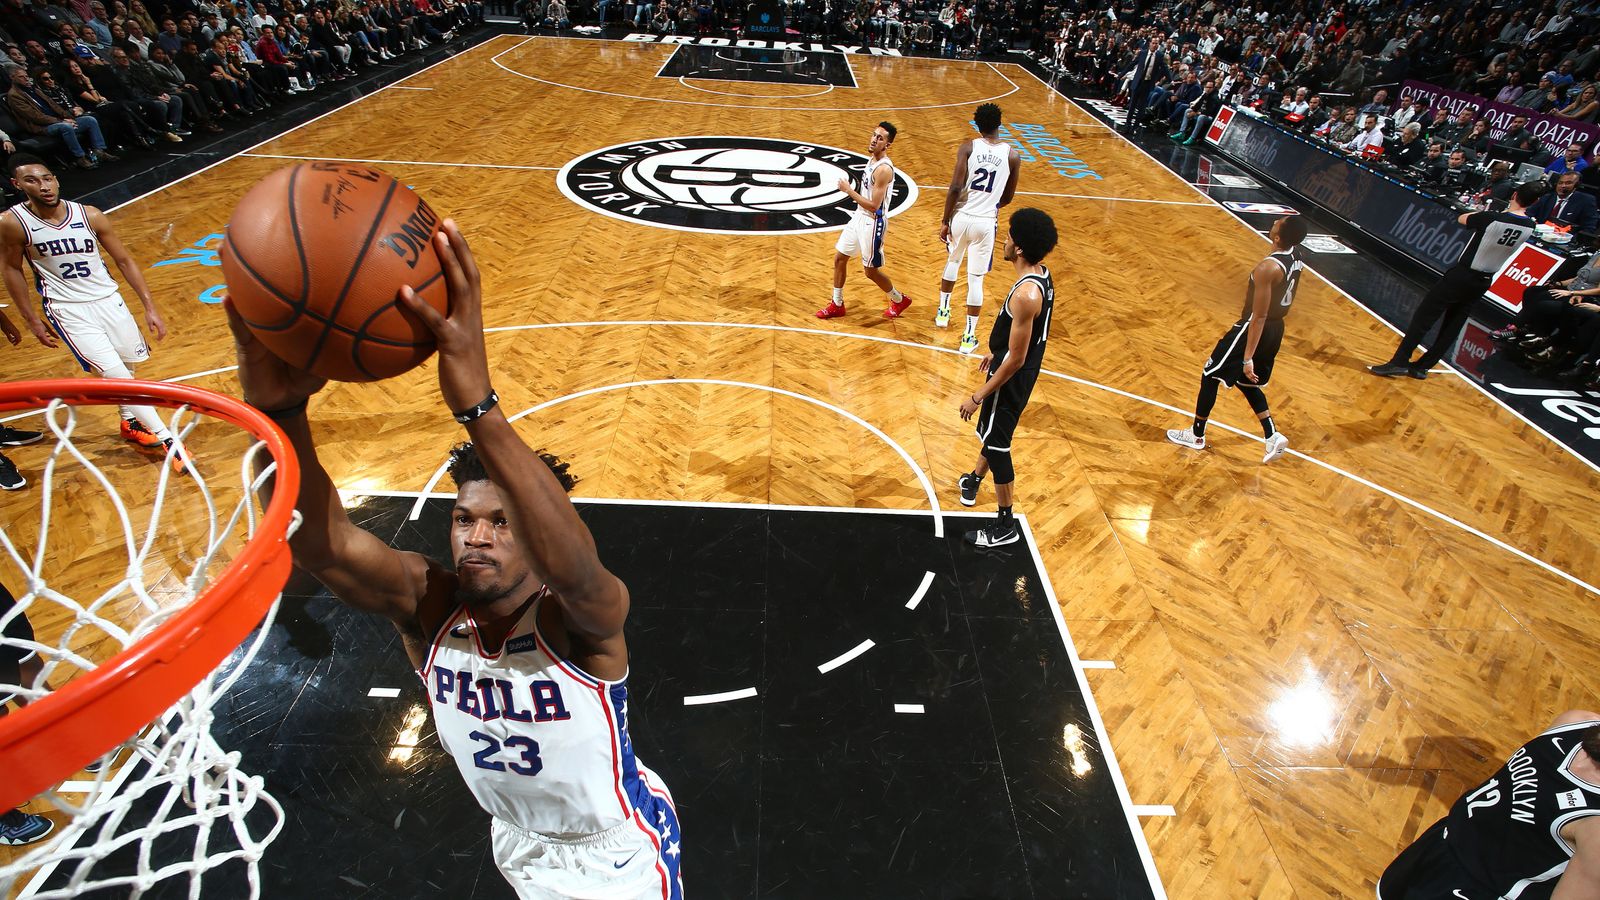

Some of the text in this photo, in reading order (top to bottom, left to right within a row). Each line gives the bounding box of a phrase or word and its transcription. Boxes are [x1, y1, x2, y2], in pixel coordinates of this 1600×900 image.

[751, 25, 780, 33] BARCLAYS
[622, 33, 904, 57] BROOKLYN
[1533, 119, 1589, 147] QATAR
[976, 154, 1003, 167] EMBIID
[1010, 123, 1103, 180] BARCLAYS
[577, 141, 687, 215] NEW YORK
[970, 167, 997, 193] 21
[1388, 202, 1465, 265] Modelo
[1497, 228, 1523, 247] 32
[34, 238, 94, 257] PHILA
[59, 261, 91, 280] 25
[1504, 262, 1539, 287] infor
[1280, 278, 1296, 307] 8
[433, 665, 572, 723] PHILA
[469, 730, 543, 777] 23
[1466, 778, 1501, 818] 12
[1507, 747, 1538, 825] ROOKLYN
[1565, 791, 1576, 807] infor
